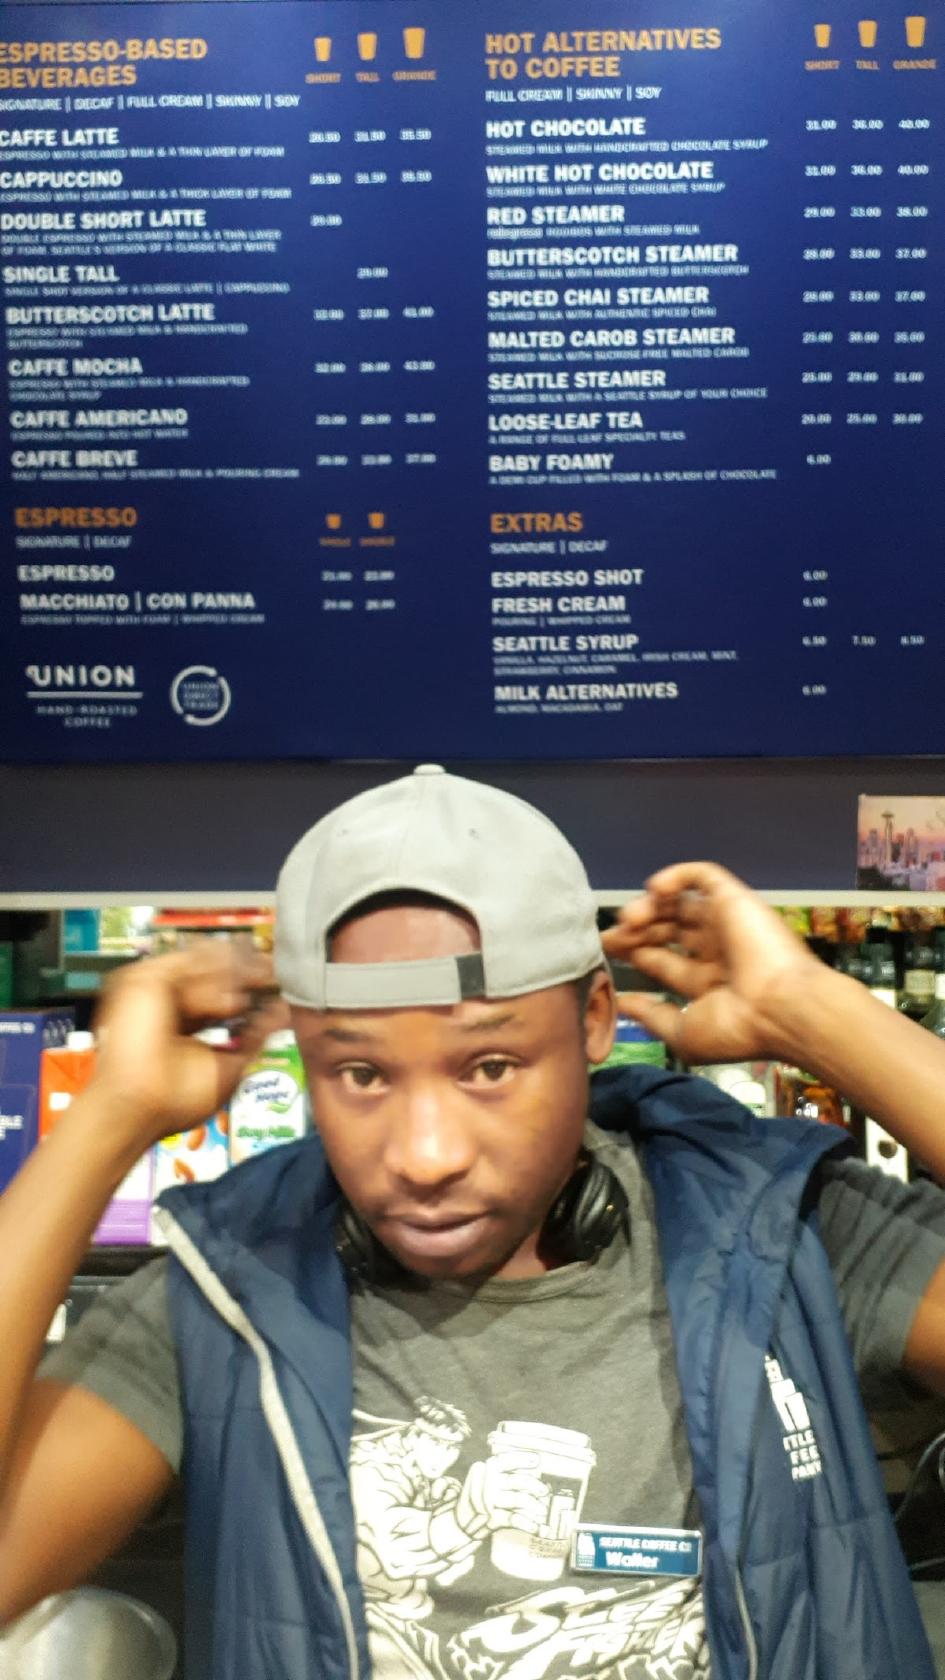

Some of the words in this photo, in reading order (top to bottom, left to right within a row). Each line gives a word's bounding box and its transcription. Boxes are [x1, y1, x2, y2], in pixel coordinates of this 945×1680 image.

[485, 33, 535, 54] HOT
[542, 28, 722, 52] ALTERNATIVES
[0, 65, 137, 88] BEVERAGES
[485, 58, 517, 80] TO
[525, 56, 620, 78] COFFEE
[74, 97, 115, 109] DECAF
[127, 95, 157, 108] FULL
[158, 94, 203, 107] CREAM
[215, 94, 262, 107] SKINNY
[274, 94, 300, 107] SOY
[485, 90, 516, 103] FULL
[517, 89, 563, 102] CREAM
[575, 88, 622, 100] SKINNY
[635, 87, 662, 99] SOY
[0, 129, 58, 147] CAFFE
[62, 128, 119, 146] LATTE
[486, 120, 525, 138] HOT
[530, 117, 646, 137] CHOCOLATE
[0, 169, 123, 188] CAPPUCCINO
[486, 165, 549, 183] WHITE
[554, 164, 593, 181] HOT
[599, 161, 714, 180] CHOCOLATE
[1, 212, 76, 230] DOUBLE
[80, 210, 144, 228] SHORT
[149, 209, 206, 227] LATTE
[486, 206, 527, 225] RED
[531, 205, 625, 224] STEAMER
[487, 247, 640, 266] BUTTERSCOTCH
[645, 244, 738, 262] STEAMER
[2, 266, 70, 283] SINGLE
[75, 265, 120, 282] TALL
[487, 290, 559, 308] SPICED
[563, 288, 611, 306] CHAI
[616, 286, 710, 305] STEAMER
[5, 305, 154, 325] BUTTERSCOTCH
[158, 303, 216, 321] LATTE
[487, 331, 565, 349] MALTED
[569, 329, 637, 347] CAROB
[642, 327, 735, 345] STEAMER
[8, 359, 69, 377] CAFFE
[72, 357, 144, 375] MOCHA
[488, 372, 569, 390] SEATTLE
[573, 370, 666, 388] STEAMER
[10, 410, 70, 428] CAFFE
[75, 408, 188, 427] AMERICANO
[488, 413, 602, 431] LOOSE-LEAF
[606, 412, 643, 428] TEA
[11, 450, 71, 468] CAFFE
[75, 449, 138, 467] BREVE
[489, 455, 541, 472] BABY
[546, 453, 614, 471] FOAMY
[15, 507, 138, 528] ESPRESSO
[490, 512, 583, 534] EXTRAS
[16, 535, 80, 549] SIGNATURE
[93, 535, 132, 548] DECAF
[490, 541, 555, 555] SIGNATURE
[568, 540, 608, 553] DECAF
[17, 564, 115, 582] ESPRESSO
[491, 570, 589, 588] ESPRESSO
[593, 568, 644, 585] SHOT
[20, 593, 129, 610] MACCHIATO
[146, 592, 187, 609] CON
[191, 592, 256, 609] PANNA
[491, 598, 552, 613] FRESH
[557, 595, 626, 612] CREAM
[493, 636, 570, 652] SEATTLE
[575, 634, 639, 650] SYRUP
[26, 665, 136, 687] UNION
[494, 685, 541, 701] MILK
[545, 682, 679, 700] ALTERNATIVES
